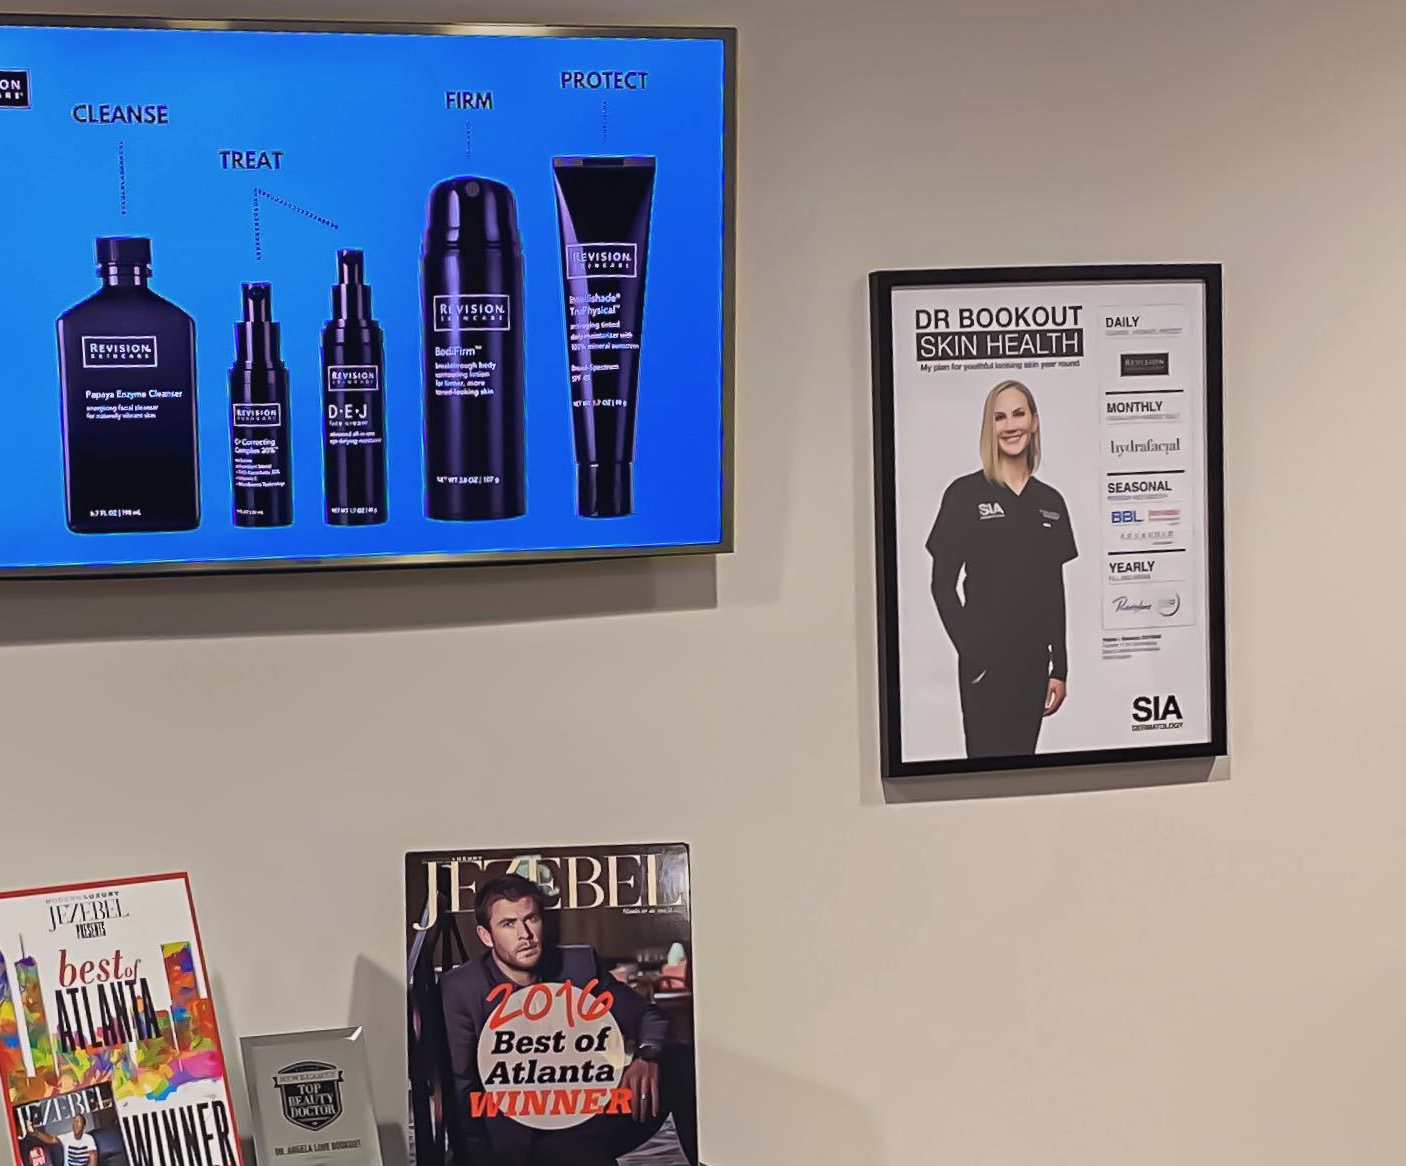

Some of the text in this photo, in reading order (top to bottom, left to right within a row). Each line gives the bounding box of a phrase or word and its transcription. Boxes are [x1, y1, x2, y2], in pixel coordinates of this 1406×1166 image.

[560, 71, 649, 90] PROTECT
[445, 91, 493, 110] FIRM
[72, 104, 169, 125] CLEANSE
[219, 149, 284, 170] TREAT
[440, 303, 505, 314] REVISION
[916, 305, 1083, 330] DR BOOKOUT
[1105, 316, 1139, 328] DAILY
[90, 343, 152, 353] REVISION
[920, 331, 1079, 358] SKIN HEALTH
[1106, 401, 1163, 413] MONTHLY
[1107, 480, 1172, 493] SEASONAL
[978, 502, 1005, 516] SIA
[1111, 510, 1144, 523] BBL
[1109, 561, 1155, 573] YEARLY
[1132, 695, 1183, 722] SIA
[49, 898, 130, 932] JEZEBEL
[59, 949, 141, 987] best of
[486, 979, 614, 1030] 2016
[55, 977, 162, 1053] ATLANTA
[491, 1026, 612, 1055] Best of
[485, 1059, 615, 1085] Atlanta
[297, 1083, 321, 1095] TOP
[288, 1093, 333, 1106] BEAUTY
[469, 1088, 634, 1118] WINNER
[16, 1086, 112, 1140] JEZEBEL
[290, 1104, 336, 1118] DOCTOR
